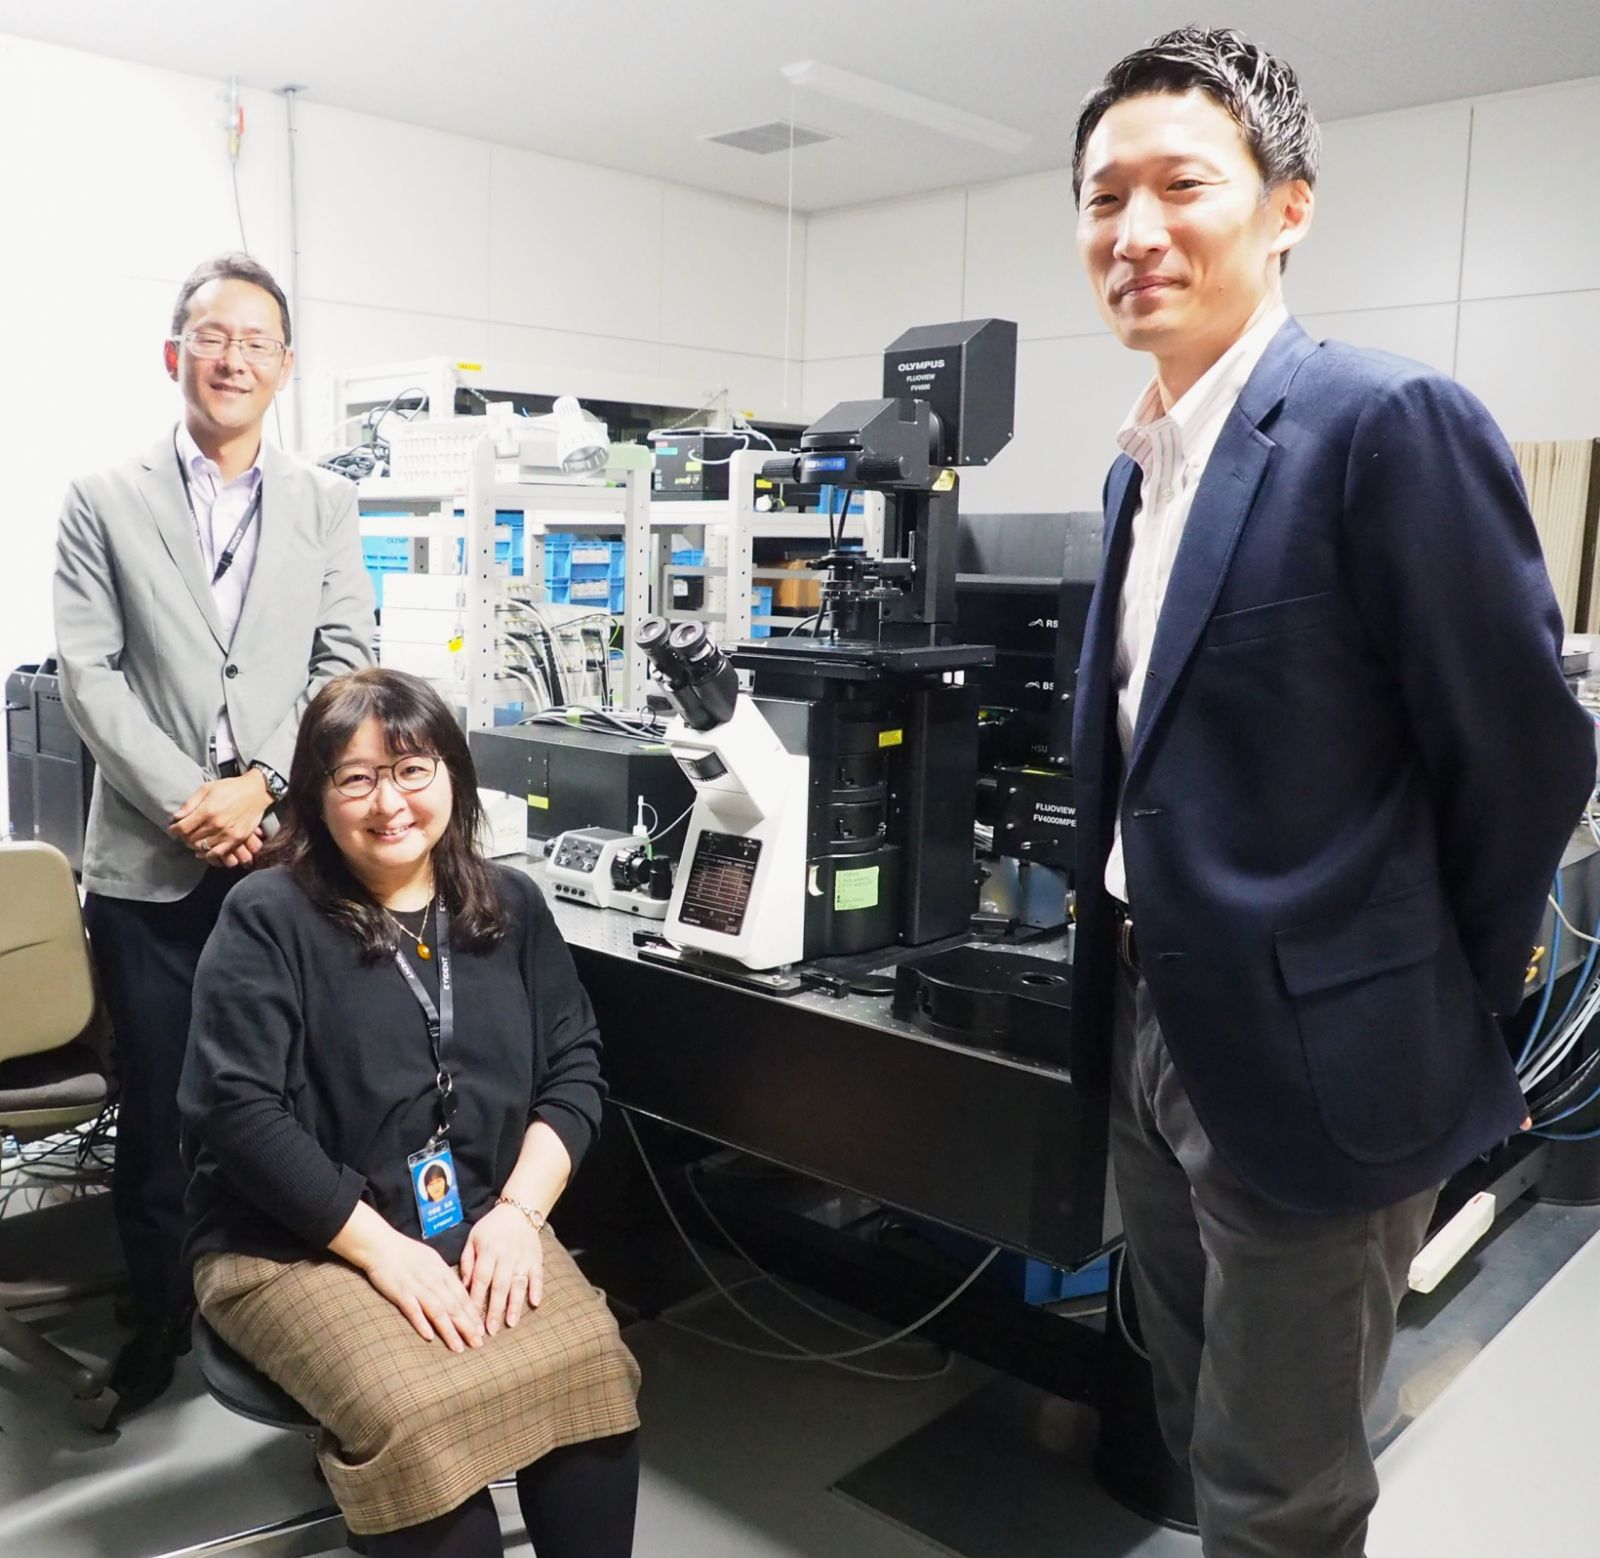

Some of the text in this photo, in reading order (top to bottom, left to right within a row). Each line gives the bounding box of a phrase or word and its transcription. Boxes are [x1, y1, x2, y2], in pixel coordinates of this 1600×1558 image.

[898, 360, 945, 371] OLYMPUS
[906, 373, 936, 381] FLUOVIEW
[1036, 803, 1076, 815] FLUOVIEW
[1033, 814, 1077, 827] FV4000MPE
